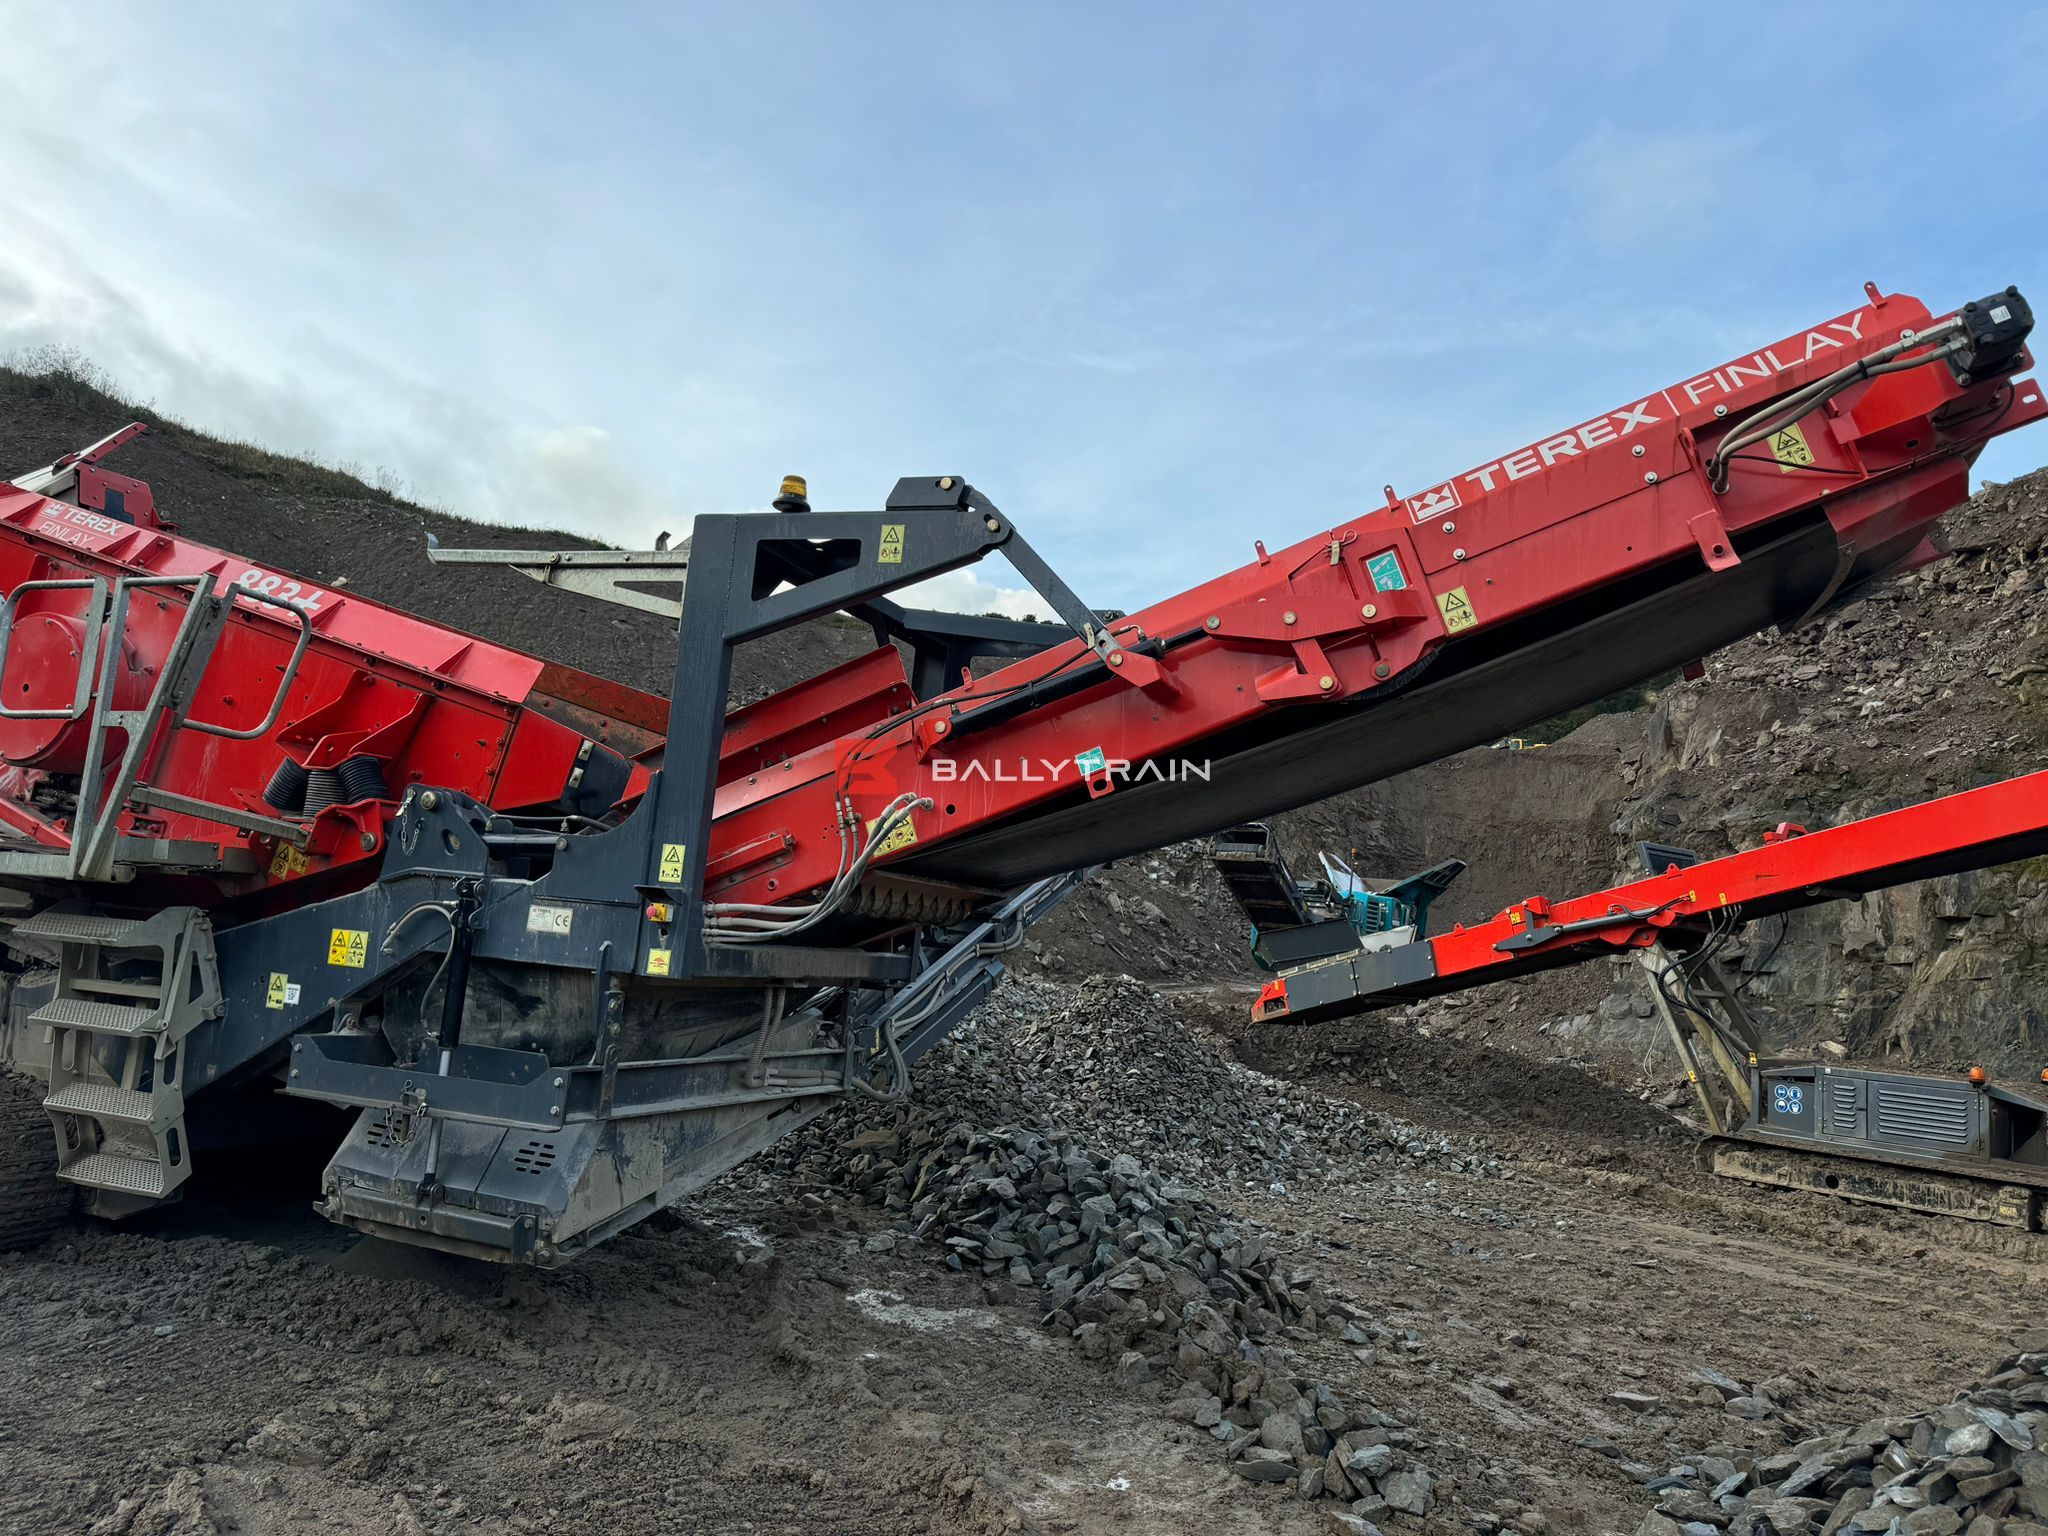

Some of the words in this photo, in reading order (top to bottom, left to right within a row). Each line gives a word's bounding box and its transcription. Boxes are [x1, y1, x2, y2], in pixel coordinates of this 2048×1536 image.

[1465, 401, 1661, 492] TEREX
[1683, 312, 1864, 405] FINLAY
[40, 521, 95, 547] FINLAY
[64, 507, 122, 536] TEREX
[555, 914, 570, 928] CE
